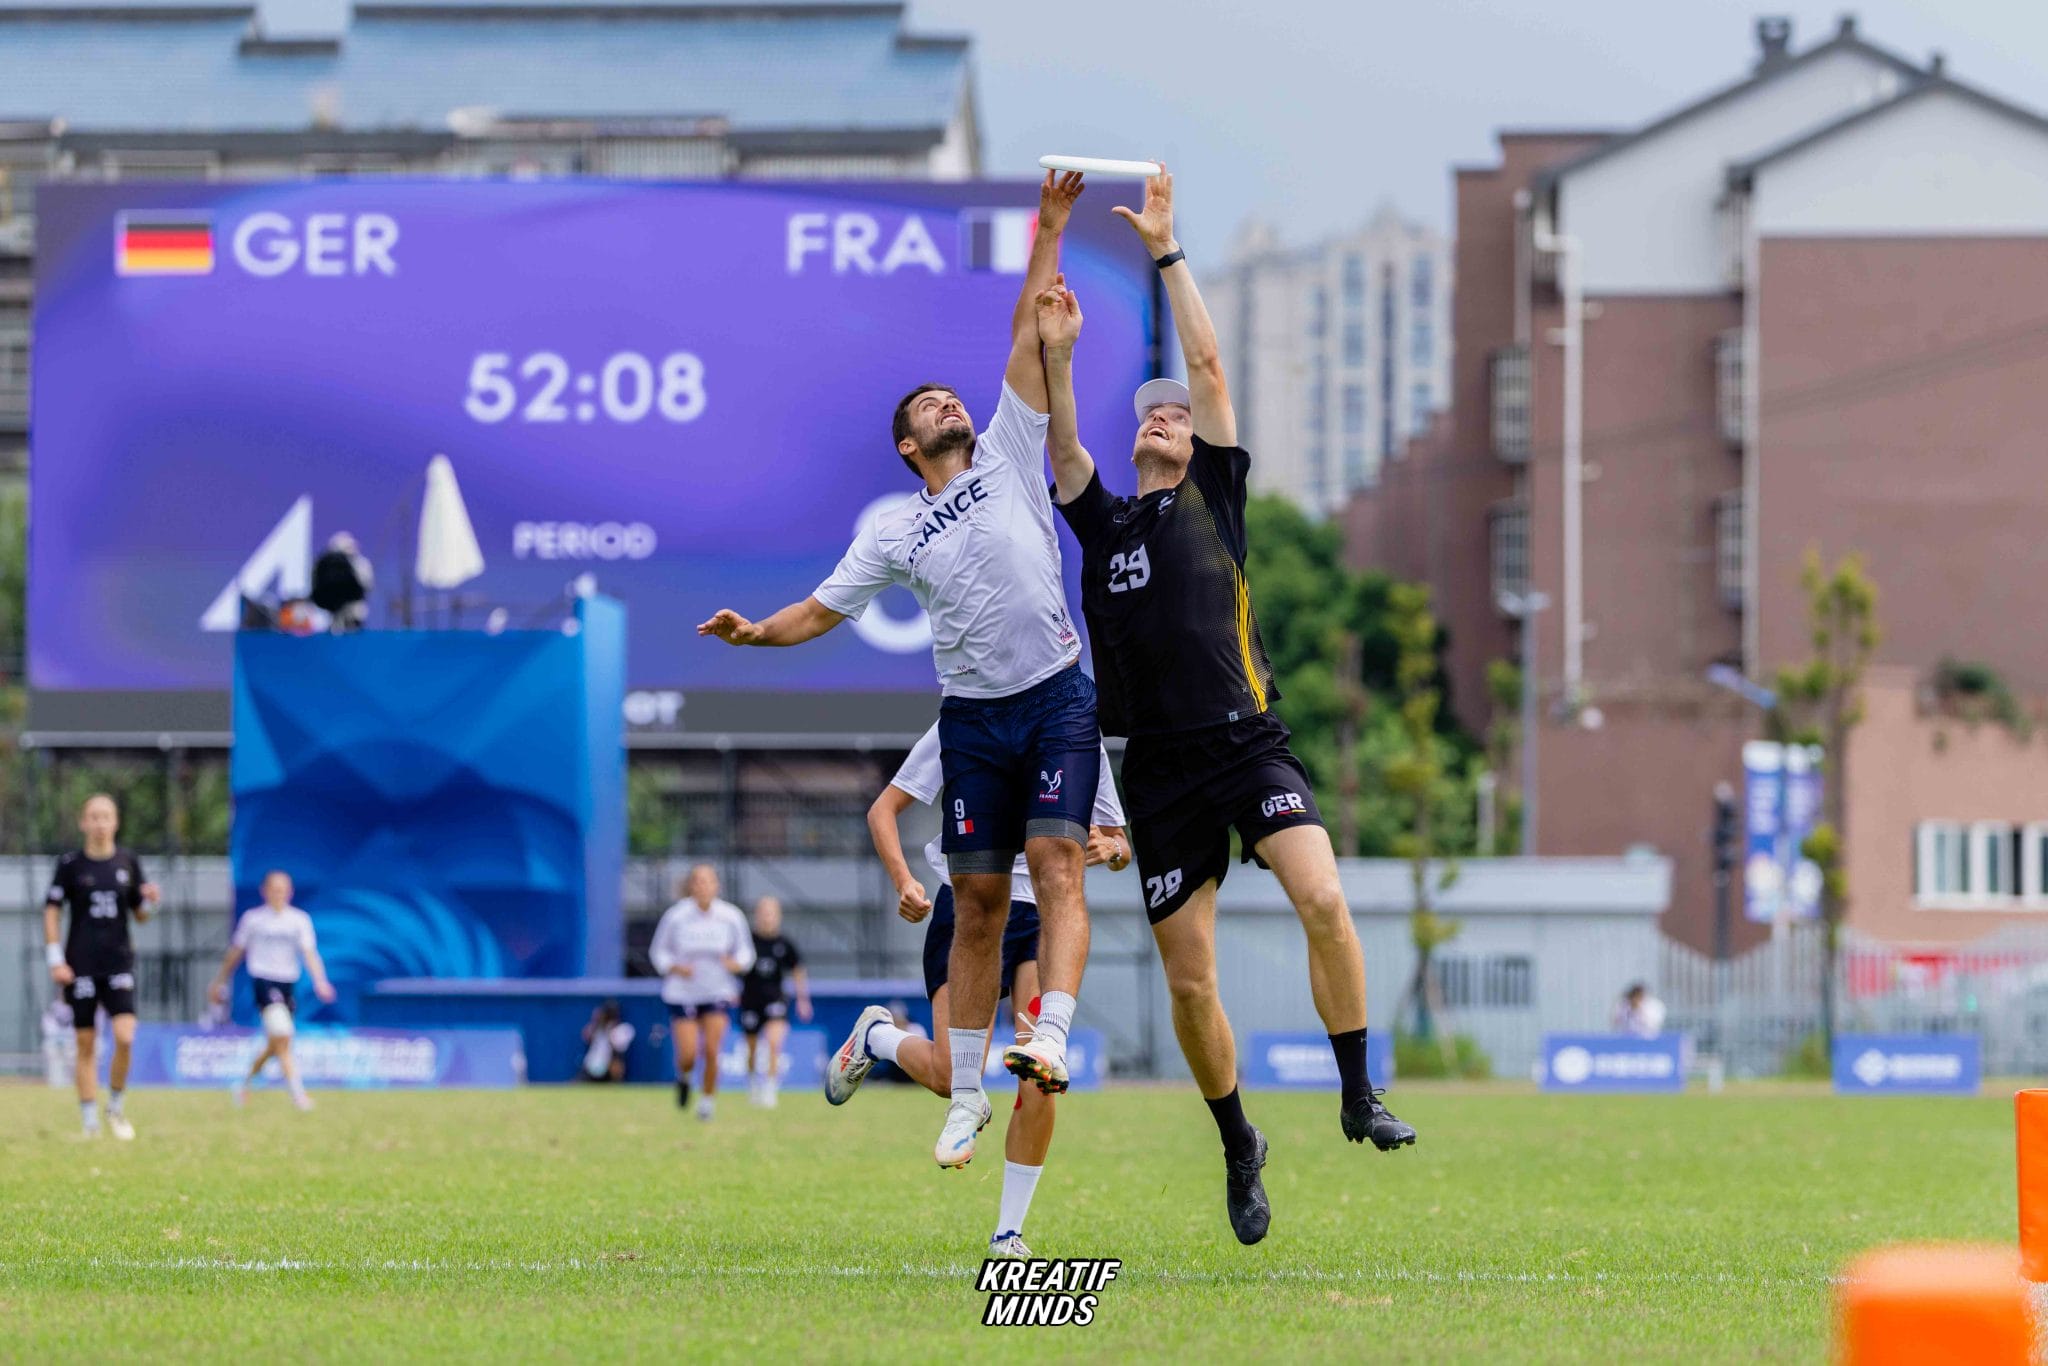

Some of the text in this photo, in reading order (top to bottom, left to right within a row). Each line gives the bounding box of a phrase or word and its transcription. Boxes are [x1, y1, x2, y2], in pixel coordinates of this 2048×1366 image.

[232, 211, 399, 277] GER
[786, 212, 945, 274] FRA
[464, 351, 708, 423] 52:08
[512, 521, 657, 560] PERIOD
[908, 478, 988, 565] ANCE
[1107, 543, 1151, 593] 29
[954, 798, 965, 820] 9
[1261, 792, 1305, 818] GER
[1146, 868, 1183, 909] 29
